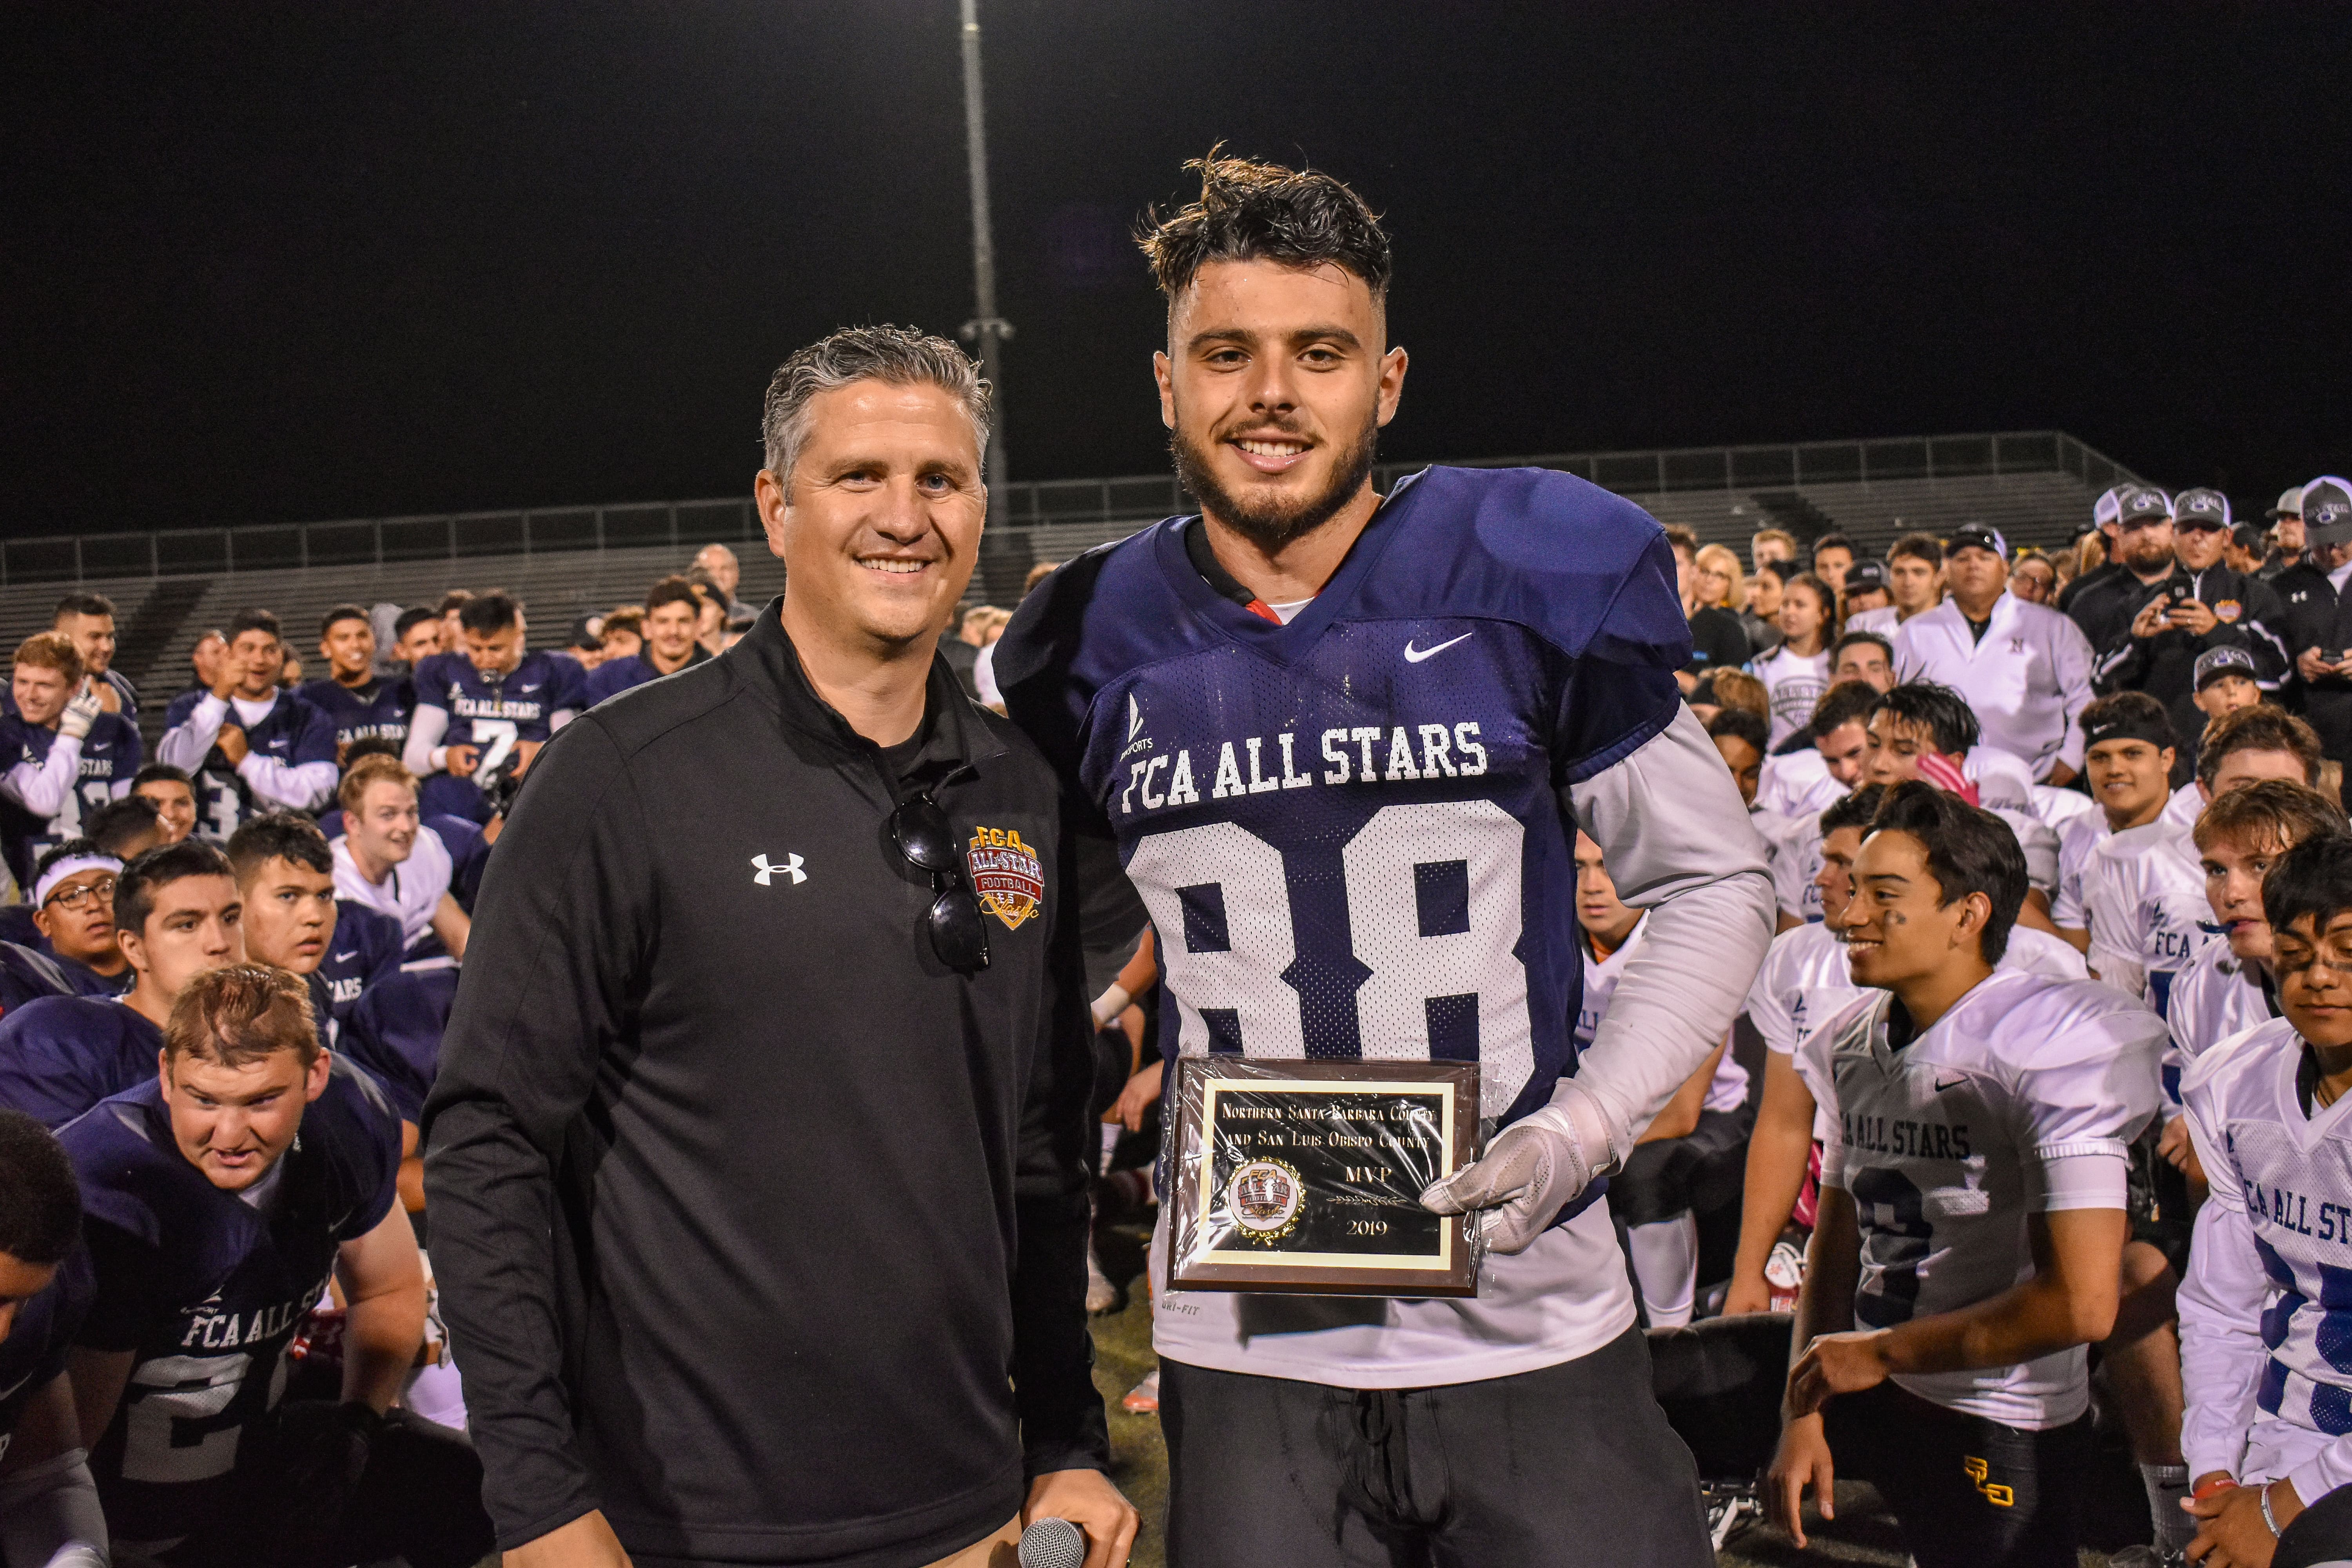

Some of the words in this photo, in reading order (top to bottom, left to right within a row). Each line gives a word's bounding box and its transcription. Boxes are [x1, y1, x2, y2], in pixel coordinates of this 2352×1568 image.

[471, 719, 518, 786] 7
[1122, 750, 1199, 813] FCA
[1212, 732, 1312, 798] ALL
[1321, 722, 1488, 786] STARS
[976, 825, 1024, 853] FCA
[981, 877, 1036, 895] FOOTBALL
[980, 897, 1039, 918] Classic
[1126, 799, 1535, 1118] 88
[2155, 931, 2190, 957] FCA
[1857, 1114, 1888, 1151] ALL
[1893, 1120, 1970, 1160] STARS
[1249, 1169, 1277, 1180] FCA
[1346, 1166, 1392, 1182] MVP
[1346, 1220, 1388, 1235] 2019
[2273, 1189, 2311, 1235] ALL
[2318, 1202, 2352, 1245] ST
[181, 1314, 240, 1348] FCA
[245, 1301, 292, 1345] ALL
[121, 1348, 292, 1483] 2
